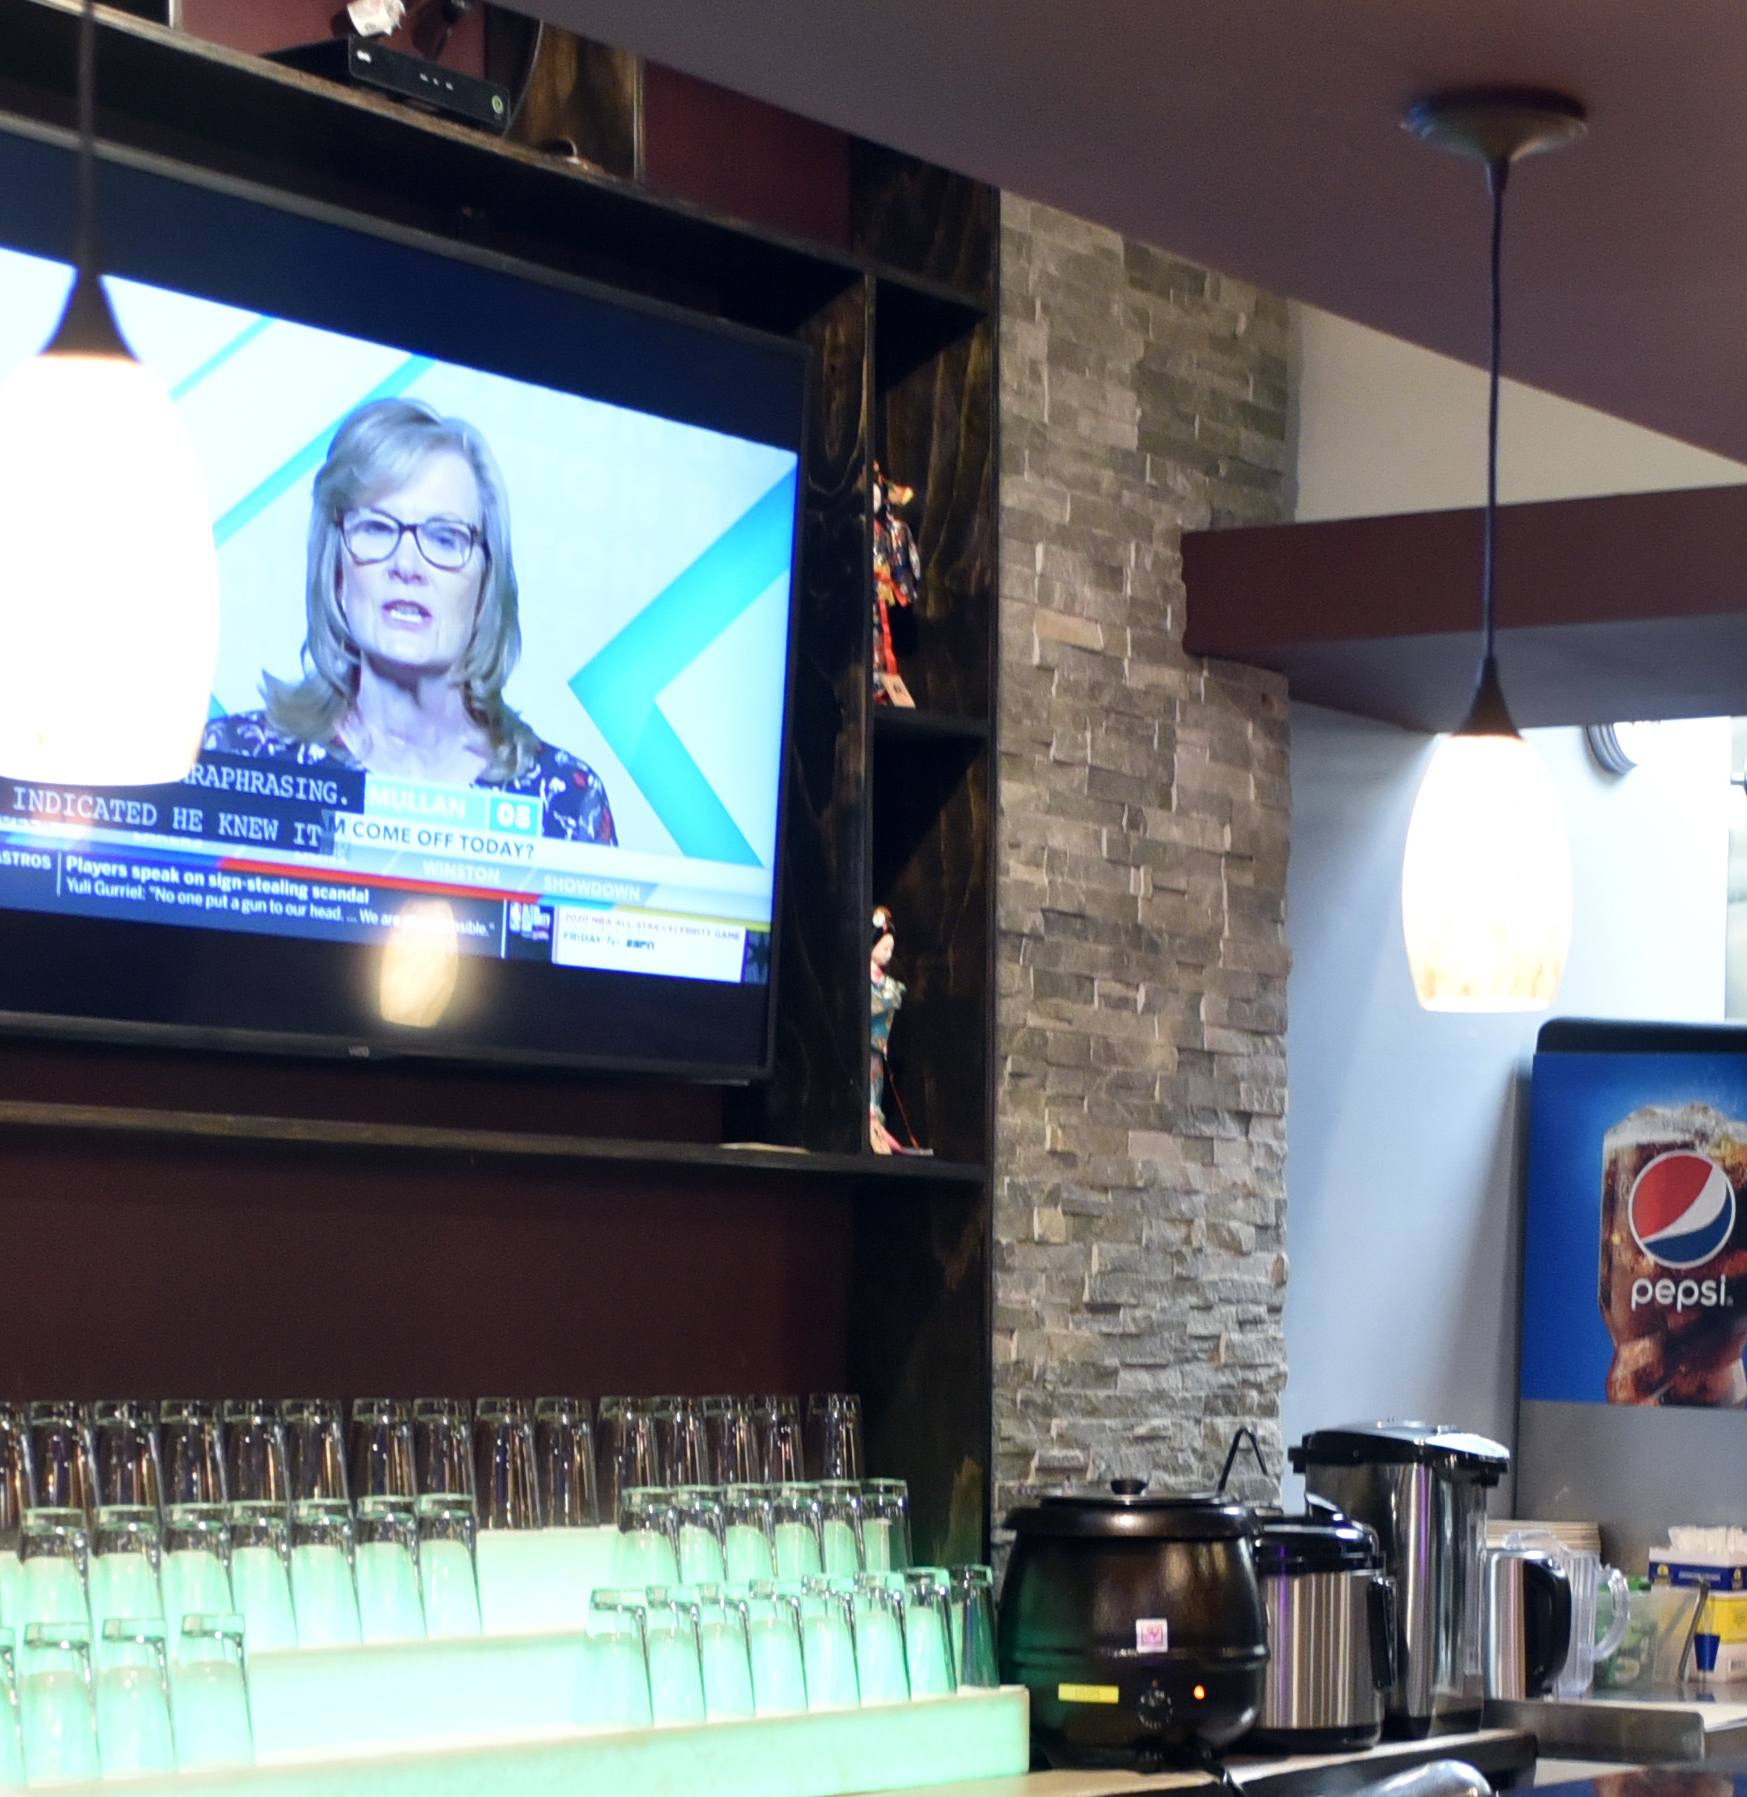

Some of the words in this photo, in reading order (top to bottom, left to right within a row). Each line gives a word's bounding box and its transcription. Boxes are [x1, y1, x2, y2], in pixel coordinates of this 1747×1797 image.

[14, 787, 157, 826] INDICATED
[174, 809, 203, 832] HE
[219, 813, 279, 841] KNEW
[294, 821, 321, 848] IT
[353, 820, 411, 844] COME
[418, 829, 454, 849] OFF
[460, 836, 535, 860] TODAY?
[66, 855, 128, 880] Players
[131, 866, 180, 885] speak
[183, 871, 205, 886] on
[312, 887, 370, 905] scandal
[543, 873, 641, 901] SHOWDOWN
[177, 892, 203, 907] one
[205, 892, 228, 910] put
[241, 898, 268, 915] gun
[269, 899, 283, 914] to
[285, 903, 307, 918] our
[1630, 1274, 1727, 1314] pepsi
